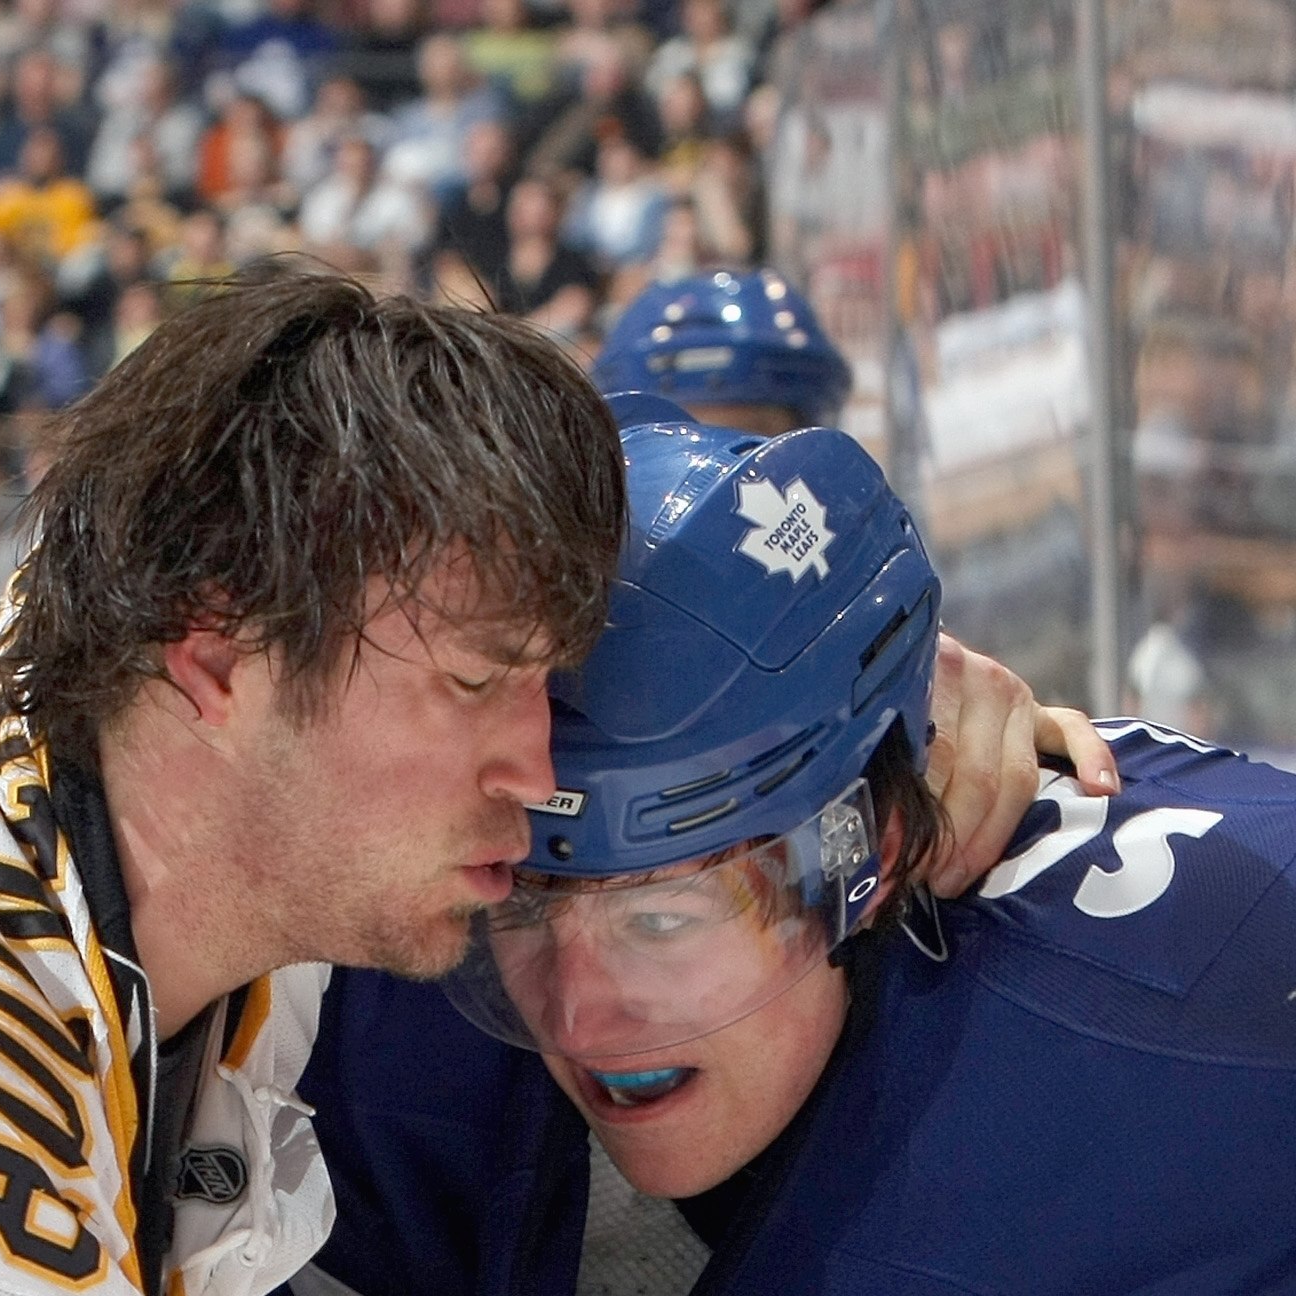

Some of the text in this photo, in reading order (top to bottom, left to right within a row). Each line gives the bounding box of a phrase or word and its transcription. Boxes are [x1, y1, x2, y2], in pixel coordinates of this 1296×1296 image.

[763, 502, 808, 551] TORONTO
[779, 518, 811, 555] MAPLE
[791, 530, 819, 562] LEAFS
